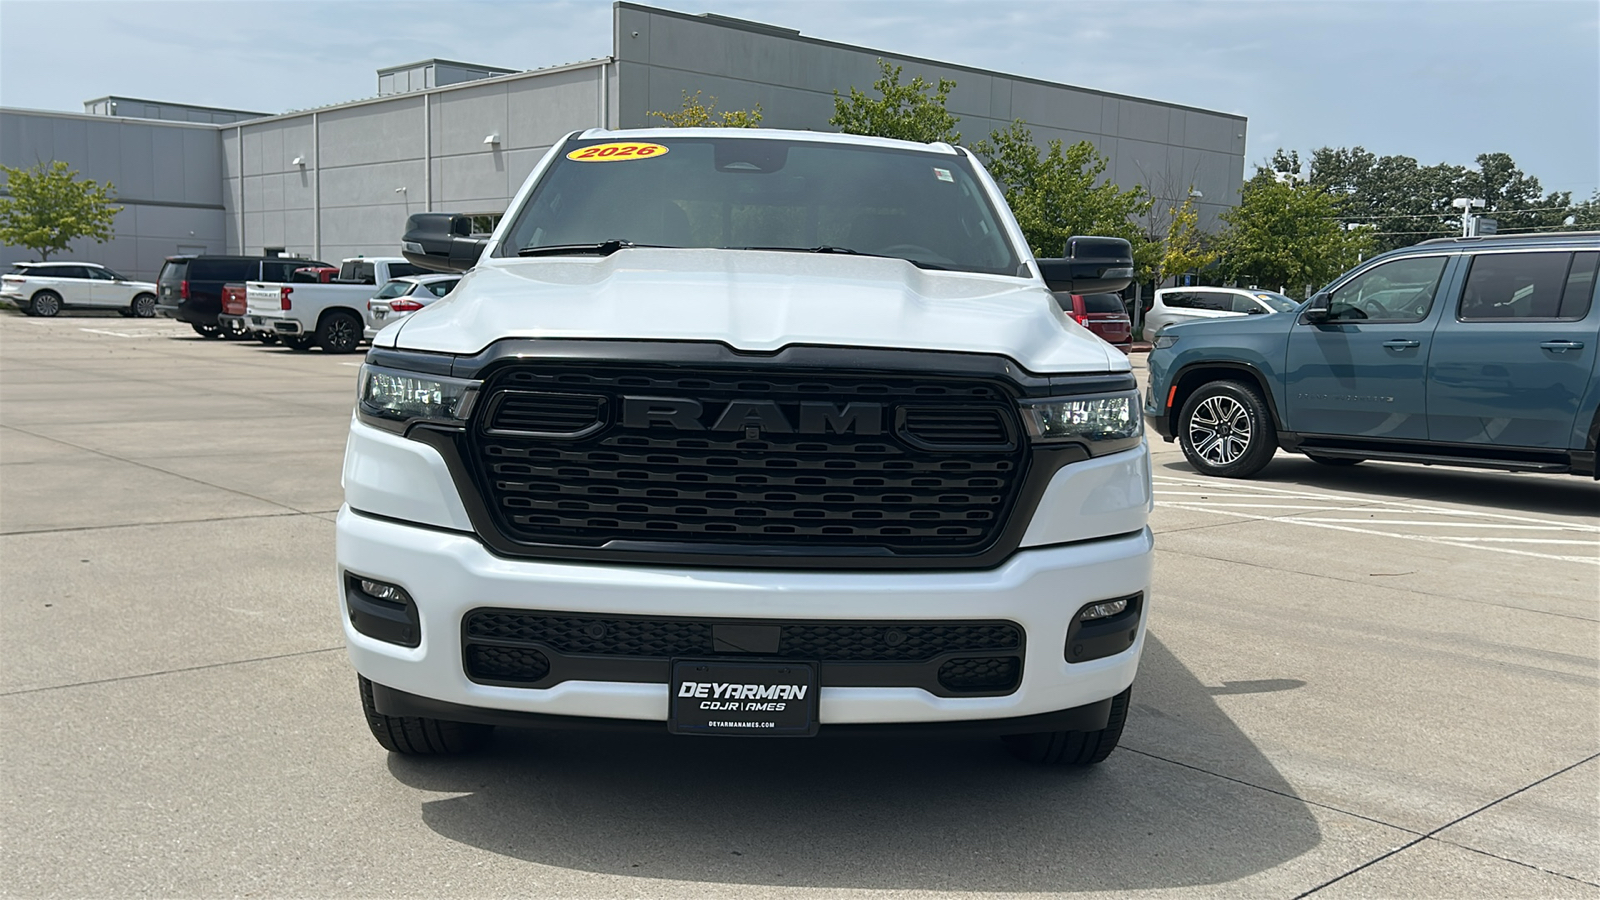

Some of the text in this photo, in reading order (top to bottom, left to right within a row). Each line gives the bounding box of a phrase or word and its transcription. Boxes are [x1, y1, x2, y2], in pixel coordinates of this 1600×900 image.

[576, 146, 658, 159] 2026
[623, 395, 882, 435] RAM
[678, 682, 808, 700] DEYARMAN
